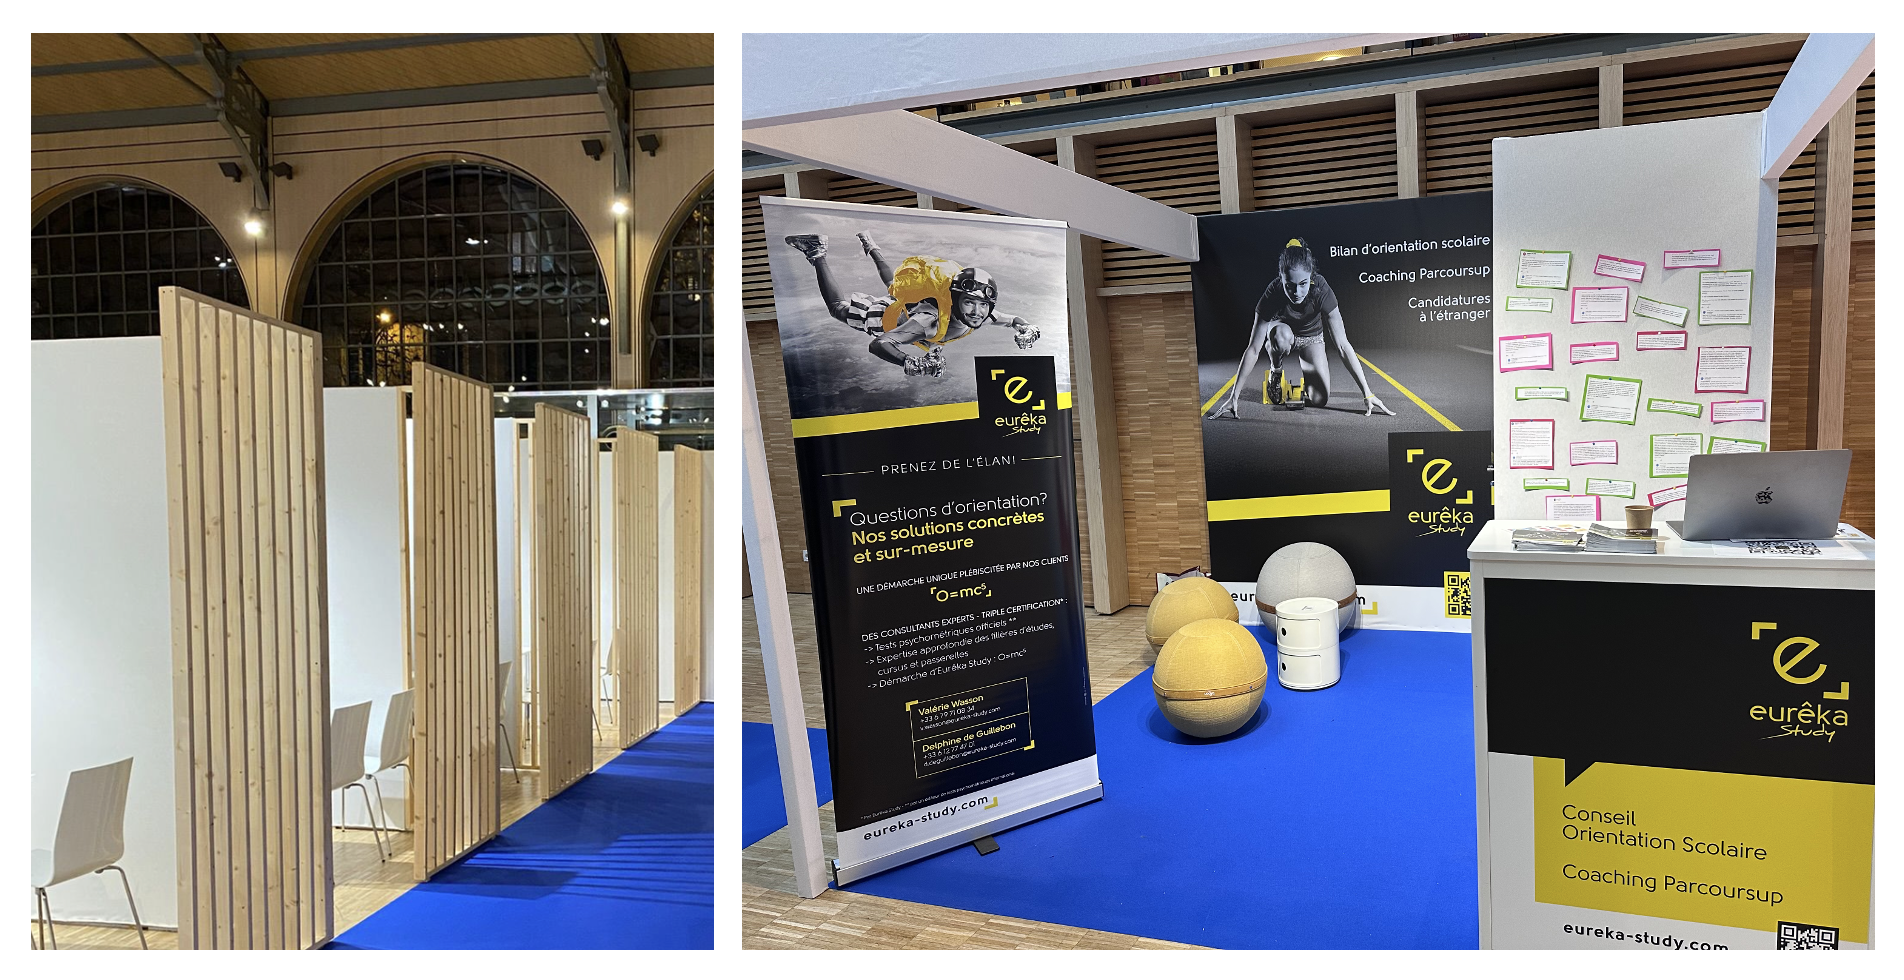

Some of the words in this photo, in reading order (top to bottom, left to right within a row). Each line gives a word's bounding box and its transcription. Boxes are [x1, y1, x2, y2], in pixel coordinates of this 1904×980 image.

[1329, 246, 1358, 258] Bilan
[1361, 239, 1438, 255] d'orientation
[1441, 234, 1491, 249] scolaire
[1358, 270, 1416, 284] Coaching
[1419, 265, 1491, 280] Parcoursup
[1408, 294, 1491, 309] Candidatures
[1419, 311, 1427, 322] à
[1430, 309, 1491, 322] l'étranger
[995, 412, 1047, 427] eurêka
[1003, 424, 1041, 437] Study
[881, 461, 936, 475] PRENEZ
[942, 459, 960, 470] DE
[850, 506, 937, 526] Questions
[941, 492, 1048, 516] d'orientation?
[1408, 506, 1474, 523] eurêka
[851, 530, 887, 546] Nos
[890, 521, 964, 540] solutions
[967, 511, 1045, 530] concrètes
[1416, 522, 1466, 537] Study
[853, 548, 872, 564] et
[875, 537, 974, 561] sur-mesure
[856, 585, 875, 595] UNE
[876, 577, 925, 592] DÉMARCHE
[926, 571, 958, 583] UNIQUE
[959, 563, 1005, 578] PLÉBISCITÉE
[1006, 562, 1021, 571] PAR
[1022, 559, 1040, 569] NOS
[1041, 554, 1069, 566] CLIENTS
[861, 632, 879, 642] DES
[880, 620, 940, 638] CONSULTANTS
[941, 613, 975, 627] EXPERTS
[981, 608, 1005, 619] TRIPLE
[875, 641, 897, 652] Tests
[899, 626, 974, 648] psychométriques
[975, 619, 1007, 632] officiels
[876, 649, 918, 664] Expertise
[919, 637, 973, 655] approfondie
[974, 634, 990, 644] des
[877, 663, 908, 676] cursus
[909, 660, 919, 669] et
[920, 650, 969, 668] passerelles
[879, 671, 928, 688] Démarche
[968, 657, 992, 668] Study
[918, 703, 950, 716] Valérie
[951, 695, 984, 708] Wasson
[1749, 701, 1849, 727] eurêka
[922, 737, 962, 752] Delphine
[963, 733, 975, 741] de
[976, 722, 1016, 738] Guillebon
[1758, 723, 1836, 743] Study
[863, 796, 989, 841] eureka-study.com
[1562, 804, 1637, 827] Conseil
[1562, 824, 1675, 851] Orientation
[1682, 836, 1767, 861] Scolaire
[1562, 863, 1657, 893] Coaching
[1664, 875, 1784, 907] Parcoursup
